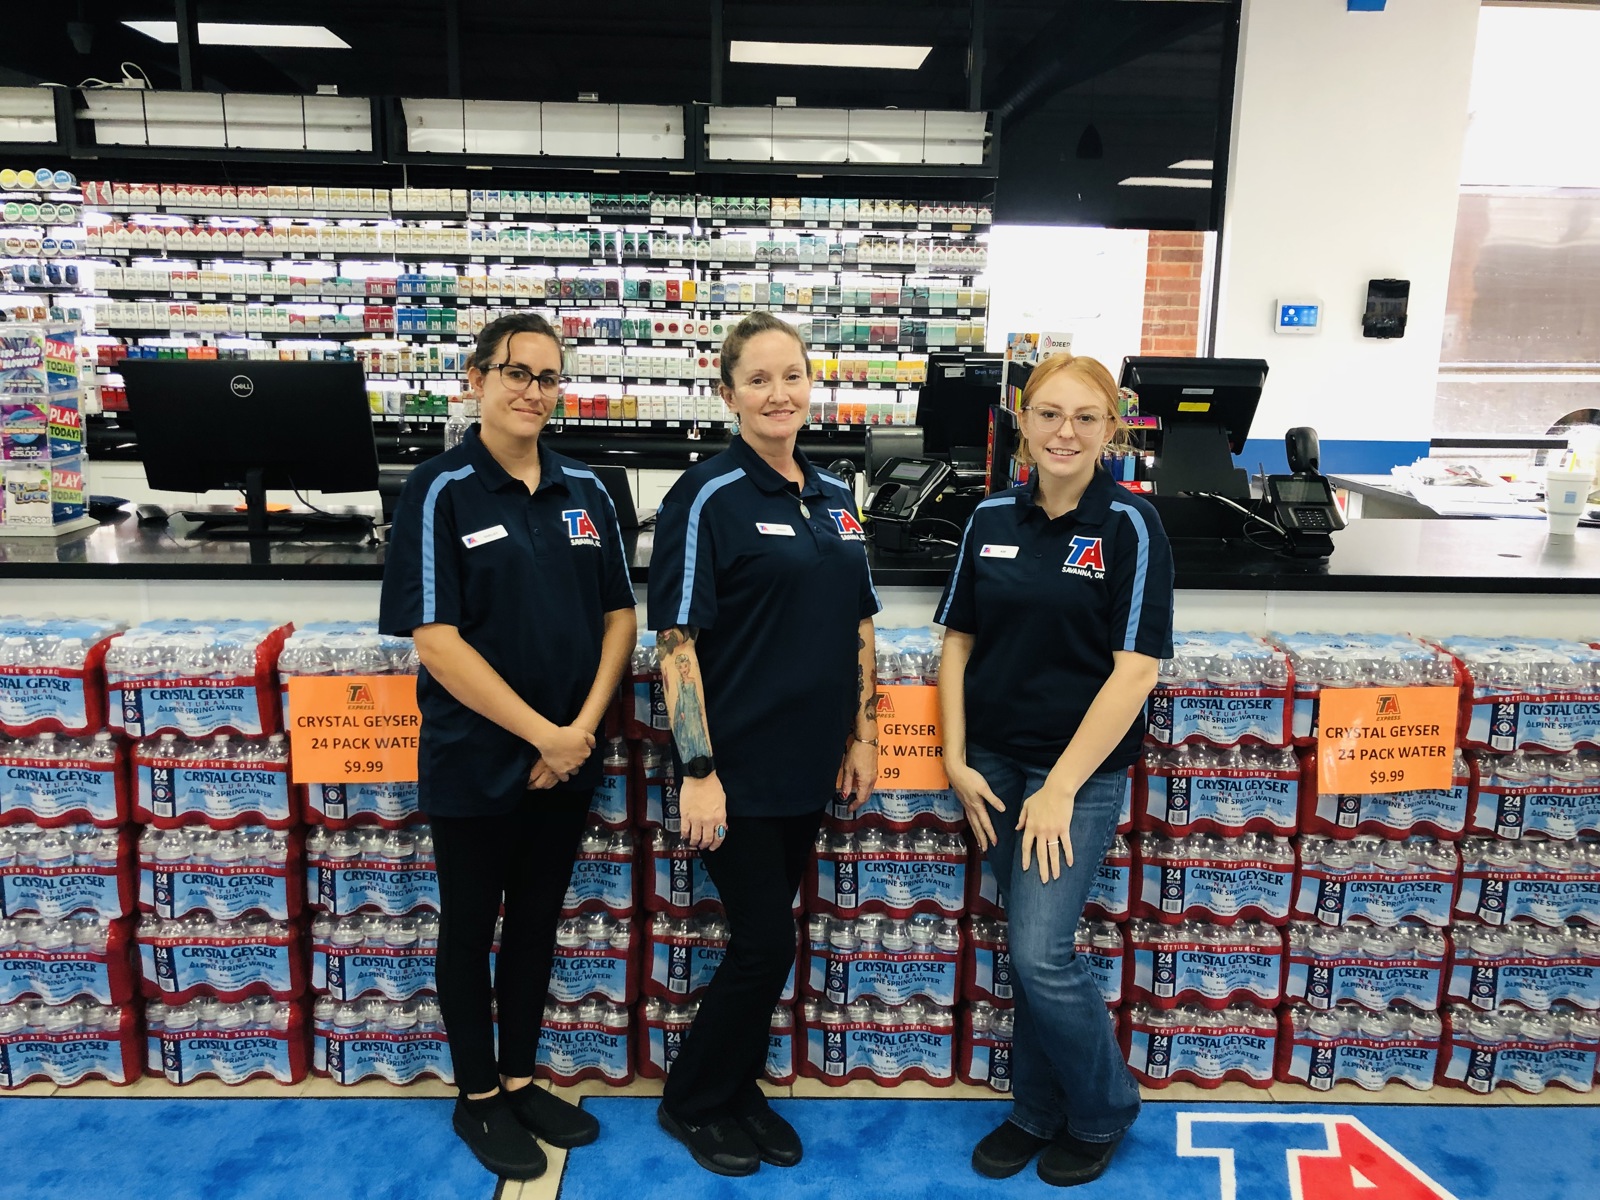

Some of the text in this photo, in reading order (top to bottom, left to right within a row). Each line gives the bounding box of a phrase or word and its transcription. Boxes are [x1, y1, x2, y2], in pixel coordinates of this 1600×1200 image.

[46, 342, 74, 359] PLAY
[46, 360, 75, 373] TODAY!
[50, 408, 78, 425] PLAY
[50, 426, 79, 438] TODAY!
[53, 472, 80, 488] PLAY
[53, 491, 81, 501] TODAY!
[562, 509, 600, 540] TA
[828, 508, 864, 534] TA
[1064, 535, 1105, 571] TA
[1062, 567, 1093, 578] SAVANNA,
[0, 678, 71, 691] STAL GEYSER
[124, 691, 135, 701] 24
[150, 689, 244, 700] CRYSTAL GEYSER
[347, 683, 374, 704] TA
[1181, 698, 1272, 711] CRYSTAL GEYSER
[1376, 694, 1400, 715] TA
[1498, 704, 1514, 715] 24
[1523, 705, 1600, 715] CRYSTAL GEYS
[297, 715, 418, 727] CRYSTAL GEYSER
[884, 724, 936, 736] GEYSER
[1326, 725, 1439, 739] CRYSTAL GEYSER
[312, 737, 417, 749] 24 PACK WATE
[893, 745, 943, 757] WATER
[1338, 746, 1446, 760] 24 PACK WATER
[344, 760, 383, 774] $9.99
[879, 768, 900, 778] .99
[7, 768, 101, 784] CRYSTAL GEYSER
[183, 771, 275, 785] CRYSTAL GEYSER
[1370, 770, 1404, 784] $9.99
[1172, 778, 1186, 789] 24
[1196, 780, 1289, 793] CRYSTAL GEYSER
[1231, 797, 1254, 805] SPRING
[1256, 795, 1283, 806] WATER
[1530, 796, 1576, 807] CRYSTAL
[322, 869, 331, 880] 24
[578, 863, 621, 875] GEYSER
[839, 863, 853, 874] 24
[865, 862, 956, 876] CRYSTAL GEYSER
[13, 876, 105, 889] CRYSTAL GEYSER
[156, 873, 167, 884] 24
[182, 874, 274, 887] CRYSTAL GEYSER
[343, 871, 437, 884] CRYSTAL GEYSER
[870, 876, 951, 889] ALPINE SPRING WATER
[1191, 869, 1284, 885] CRYSTAL GEYSER
[1225, 884, 1250, 896] SPRING
[1250, 884, 1278, 897] WATER
[1325, 882, 1341, 893] 24
[1350, 882, 1442, 894] CRYSTAL GEYSER
[1514, 882, 1600, 894] CRYSTAL GEYSE
[182, 947, 277, 959] CRYSTAL GEYSER
[673, 947, 686, 958] 24
[330, 956, 339, 967] 24
[352, 957, 435, 969] CRYSTAL GEYSE
[570, 959, 616, 970] GEYSER
[1181, 954, 1272, 967] CRYSTAL GEYSER
[3, 961, 96, 973] CRYSTAL GEYSER
[855, 962, 945, 974] CRYSTAL GEYSER
[1313, 968, 1328, 978] 24
[1503, 967, 1593, 978] CRYSTAL GEYSER
[1338, 968, 1428, 980] CRYSTAL GEYSER
[887, 976, 940, 986] SPRING WATER
[540, 1029, 618, 1047] RYSTAL GEYSER
[667, 1032, 681, 1043] 24
[852, 1032, 942, 1046] CRYSTAL GEYSER
[1153, 1036, 1168, 1047] 24
[1176, 1036, 1267, 1050] CRYSTAL GEYSER
[16, 1041, 109, 1054] CRYSTAL GEYSER
[189, 1039, 278, 1051] CRYSTAL GEYSER
[330, 1040, 339, 1051] 24
[352, 1041, 442, 1054] CRYSTAL GEYSER
[1317, 1049, 1332, 1059] 24
[1340, 1047, 1428, 1060] CRYSTAL GEYSER
